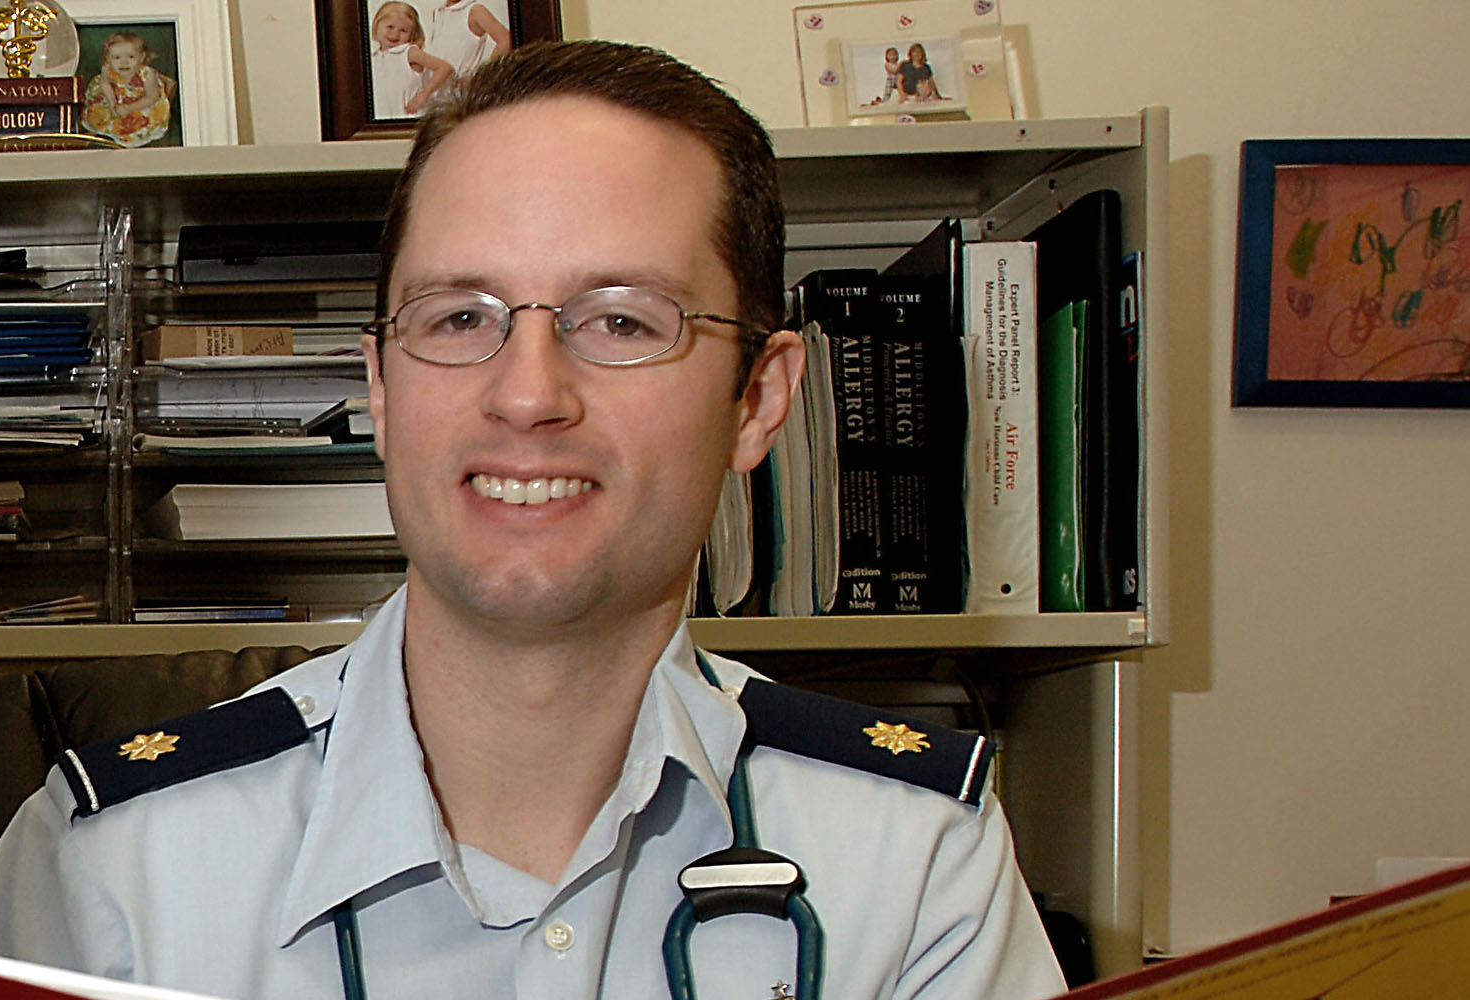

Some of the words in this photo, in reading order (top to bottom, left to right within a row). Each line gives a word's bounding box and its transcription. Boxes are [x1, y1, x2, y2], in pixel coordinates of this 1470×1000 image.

[825, 286, 869, 297] VOLUME
[997, 258, 1007, 312] Guidelines
[843, 300, 851, 318] 1
[879, 294, 923, 304] VOLUME
[1009, 284, 1020, 316] Expert
[895, 306, 906, 324] 2
[983, 281, 994, 344] Management
[998, 314, 1007, 329] for
[998, 331, 1008, 347] the
[1011, 319, 1020, 346] Panel
[986, 347, 995, 358] of
[986, 361, 996, 399] Asthma
[996, 350, 1008, 400] Diagnosis
[1010, 350, 1021, 384] Report
[842, 336, 864, 442] ALLERGY
[893, 342, 914, 448] ALLERGY
[1011, 386, 1021, 397] 3:
[1006, 422, 1018, 447] Air
[993, 462, 1002, 484] Child
[1005, 450, 1019, 491] Force
